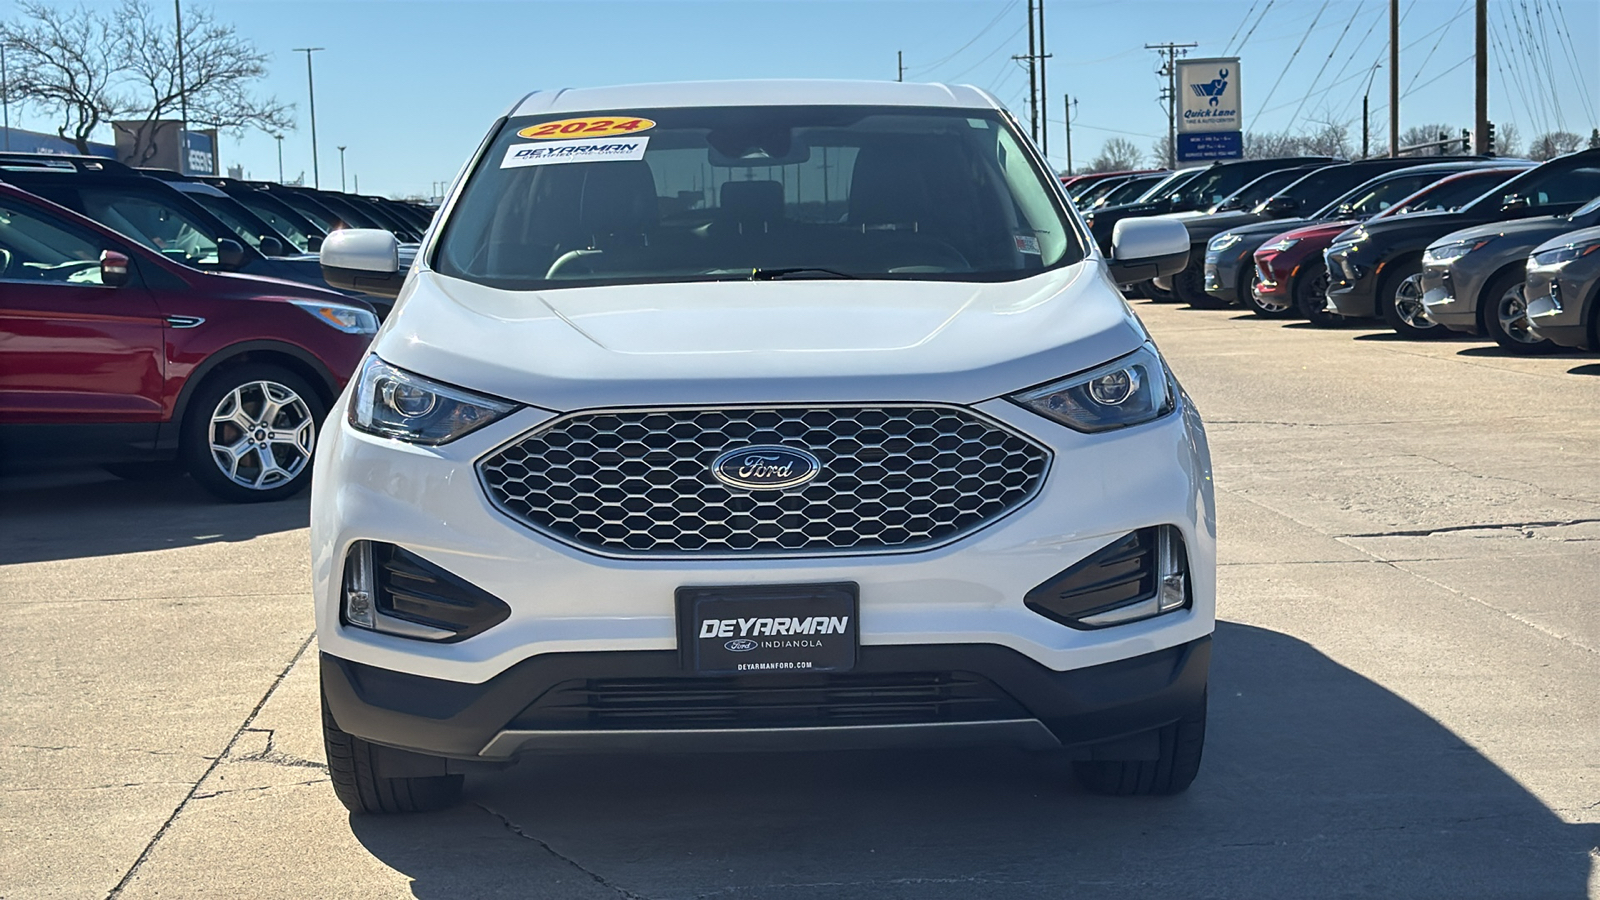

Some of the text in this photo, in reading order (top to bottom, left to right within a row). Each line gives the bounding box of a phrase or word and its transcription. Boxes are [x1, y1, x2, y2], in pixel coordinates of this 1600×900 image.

[1184, 108, 1236, 119] Quick Lane
[530, 119, 643, 137] 2024
[515, 143, 639, 157] DEYARMAN
[522, 152, 572, 160] CERTIFIED
[738, 455, 793, 478] Ford
[699, 616, 848, 639] DEYARMAN
[761, 640, 822, 648] INDIANOLA
[737, 661, 812, 671] DEYARMANFORD.COM
